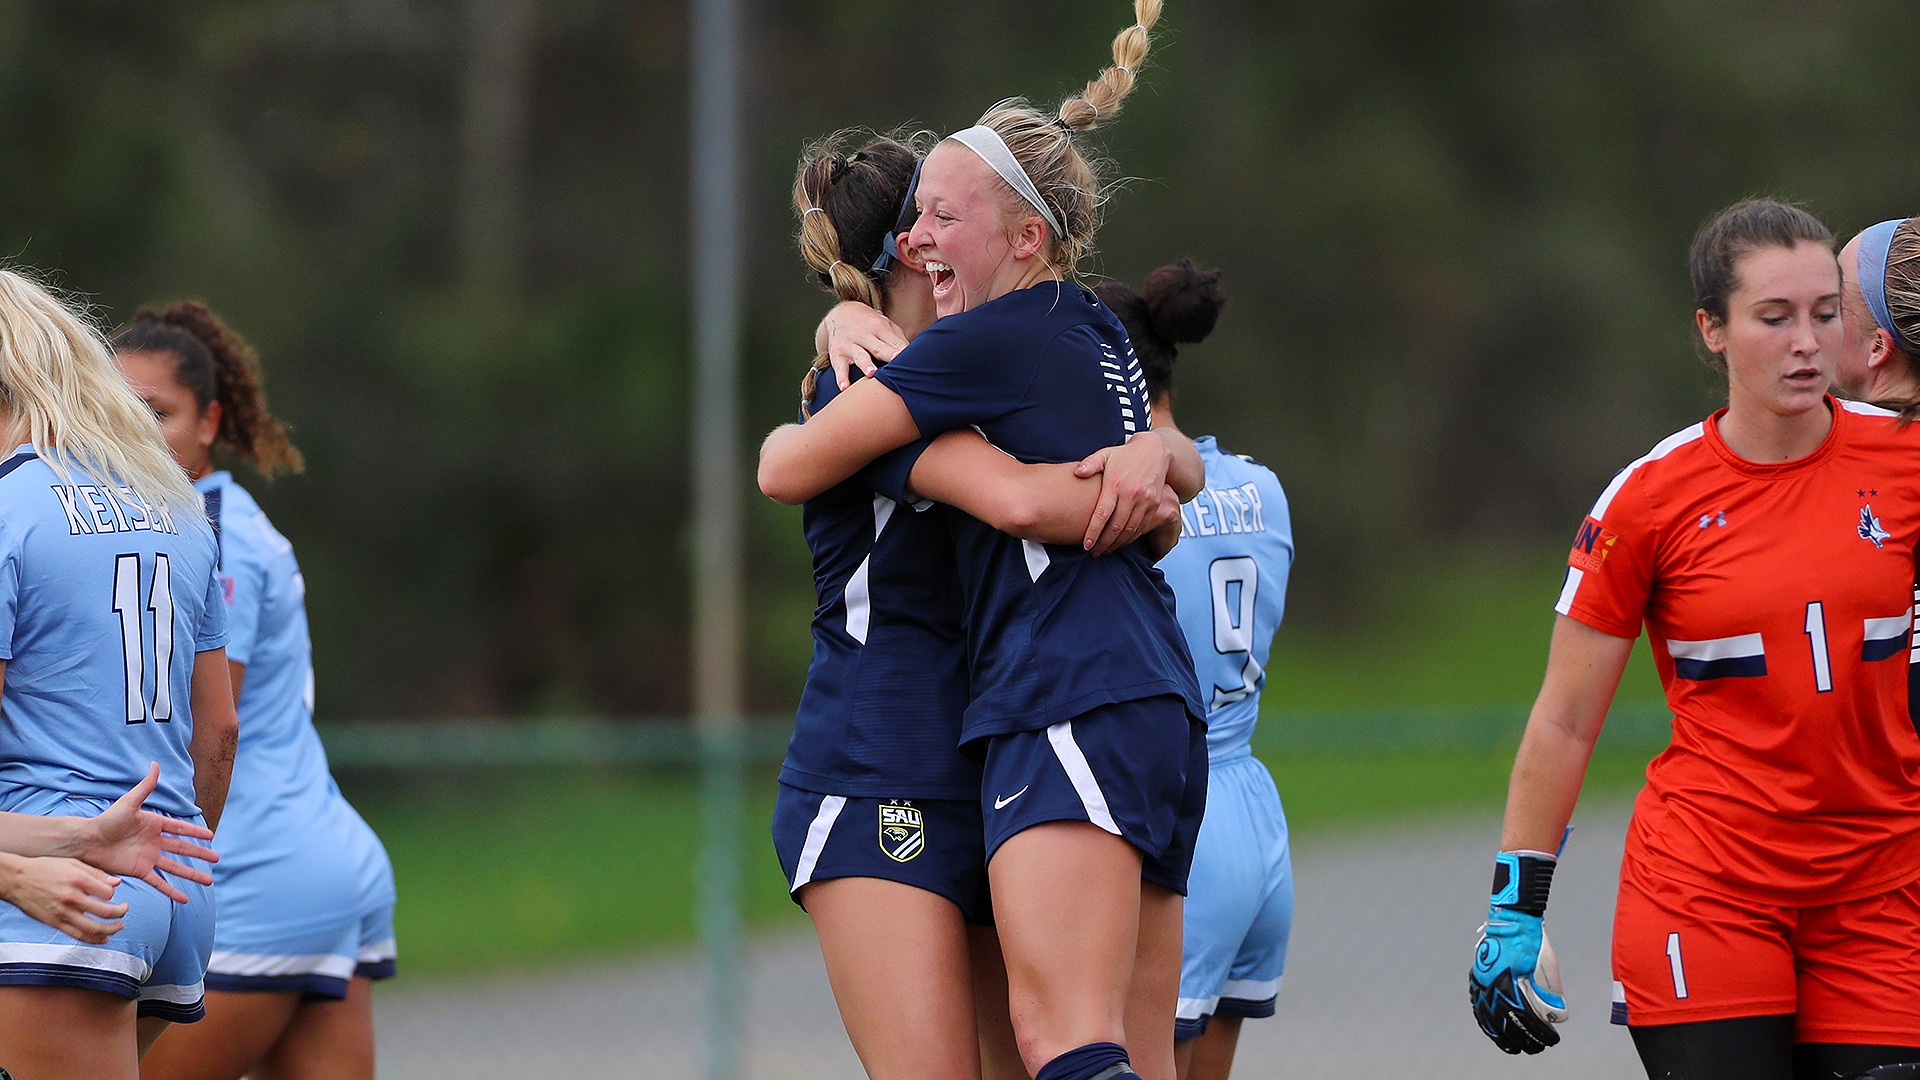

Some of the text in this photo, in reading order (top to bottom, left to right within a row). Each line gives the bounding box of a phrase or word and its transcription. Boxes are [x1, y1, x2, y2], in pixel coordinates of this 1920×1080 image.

[112, 553, 174, 725] 11
[1208, 555, 1262, 713] 9
[1804, 600, 1834, 693] 1
[883, 808, 920, 825] SAU
[1666, 932, 1688, 999] 1
